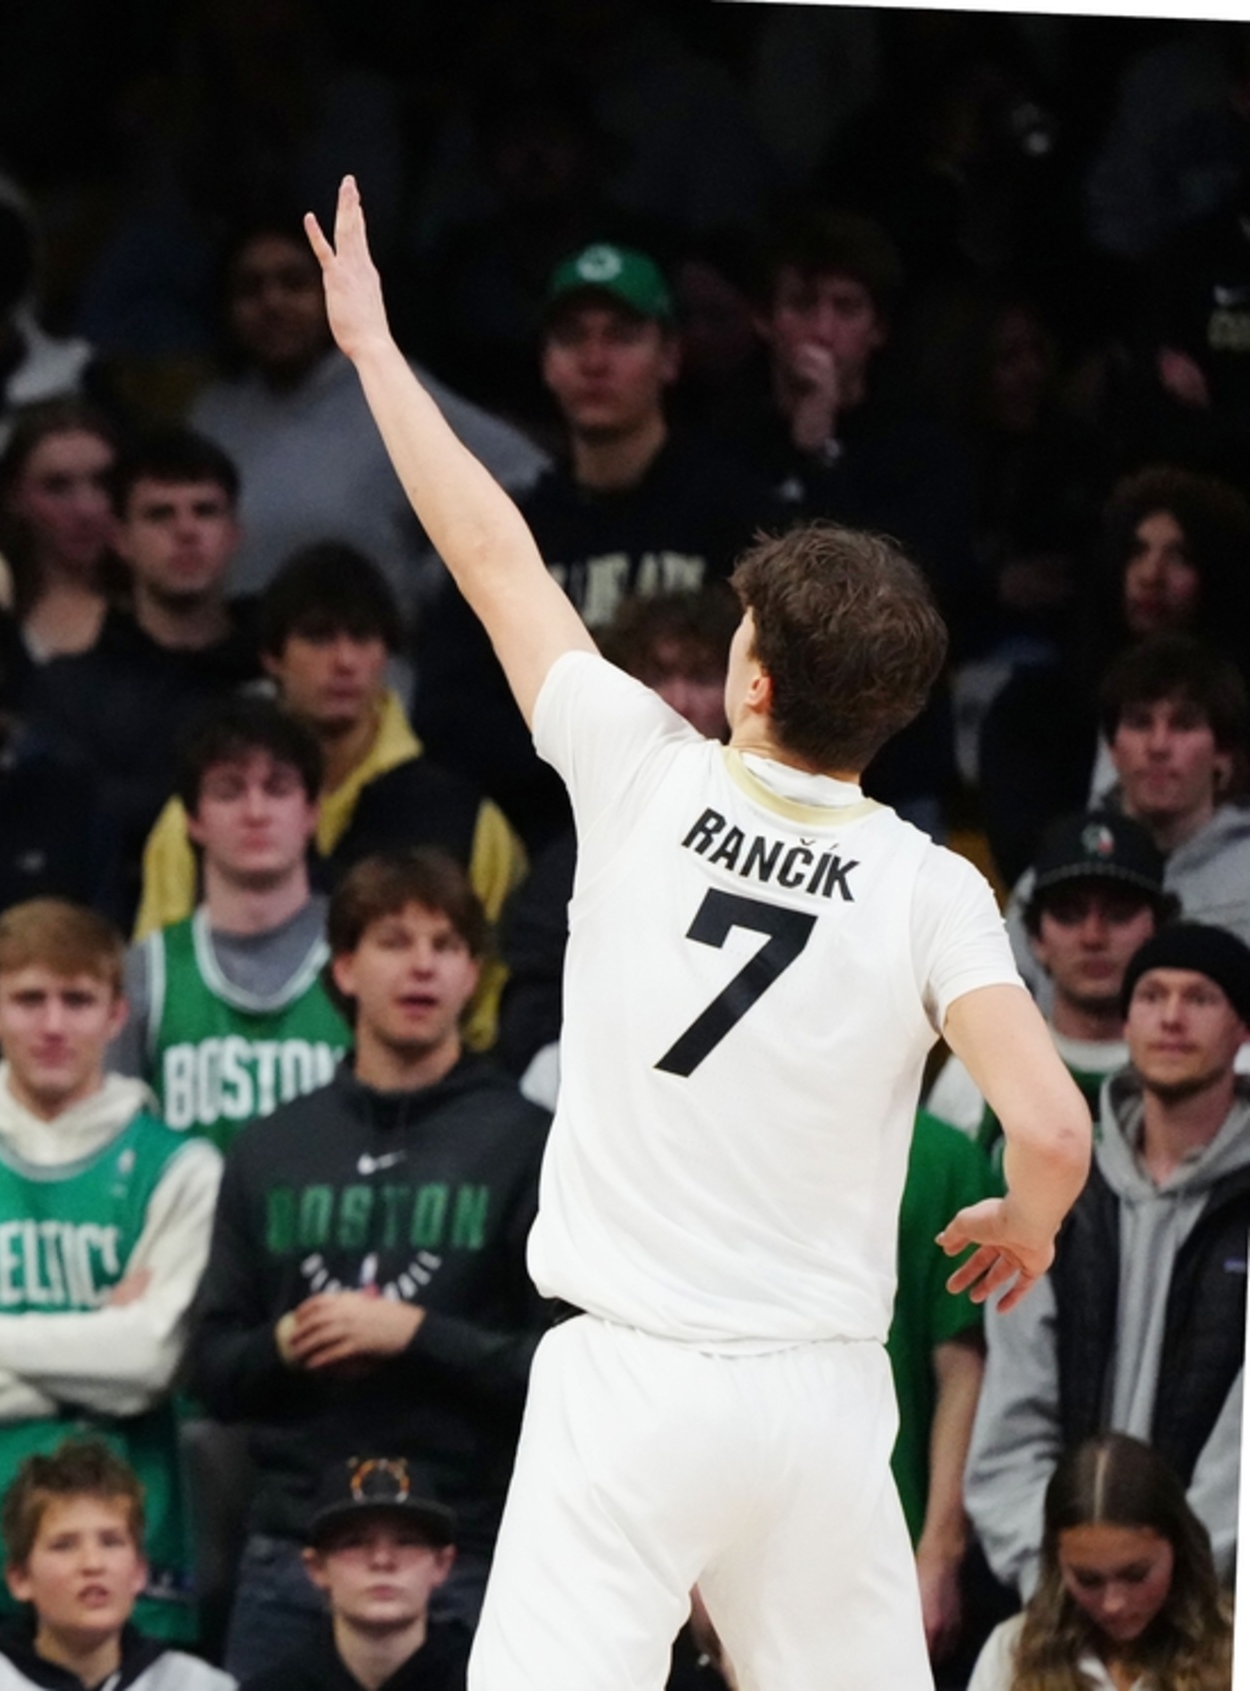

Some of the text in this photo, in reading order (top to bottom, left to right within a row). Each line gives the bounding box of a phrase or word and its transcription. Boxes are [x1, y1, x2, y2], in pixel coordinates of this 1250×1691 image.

[681, 808, 860, 902] RANČÍK
[654, 887, 818, 1078] 7
[264, 1182, 490, 1252] BOSTON
